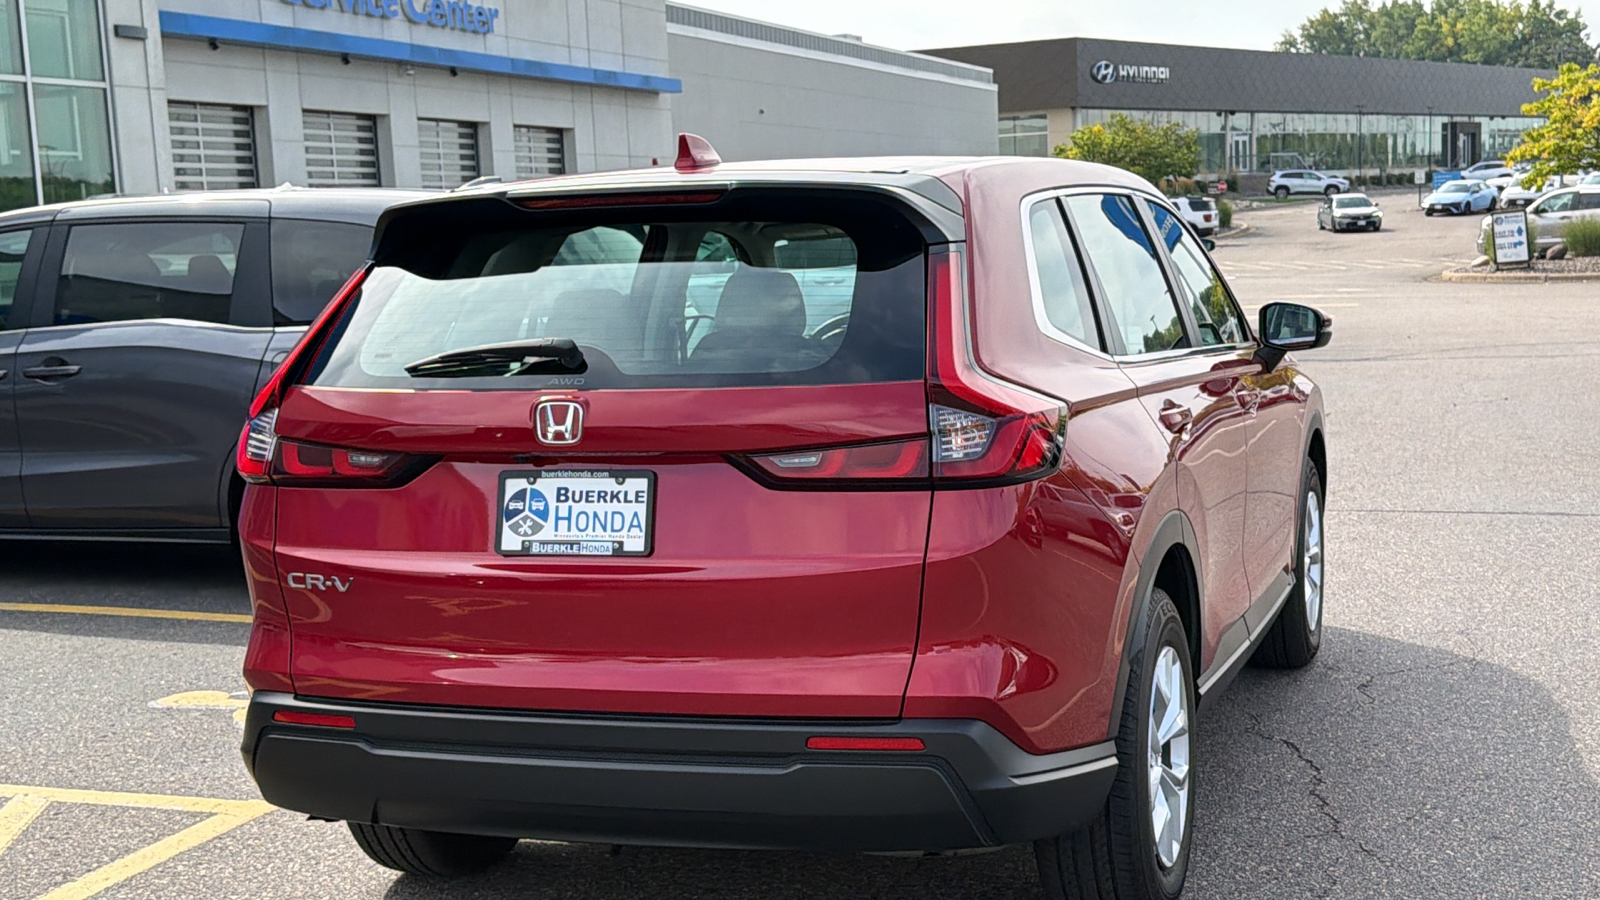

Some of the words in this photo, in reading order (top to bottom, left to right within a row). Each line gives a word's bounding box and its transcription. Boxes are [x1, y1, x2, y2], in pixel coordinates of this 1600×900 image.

[401, 0, 499, 34] Center
[548, 377, 585, 385] AWD
[541, 470, 609, 478] buerklehonda.com
[556, 486, 646, 504] BUERKLE
[554, 505, 643, 533] HONDA
[532, 542, 580, 553] BUERKLE
[581, 543, 611, 553] HONDA
[287, 572, 354, 592] CR-V
